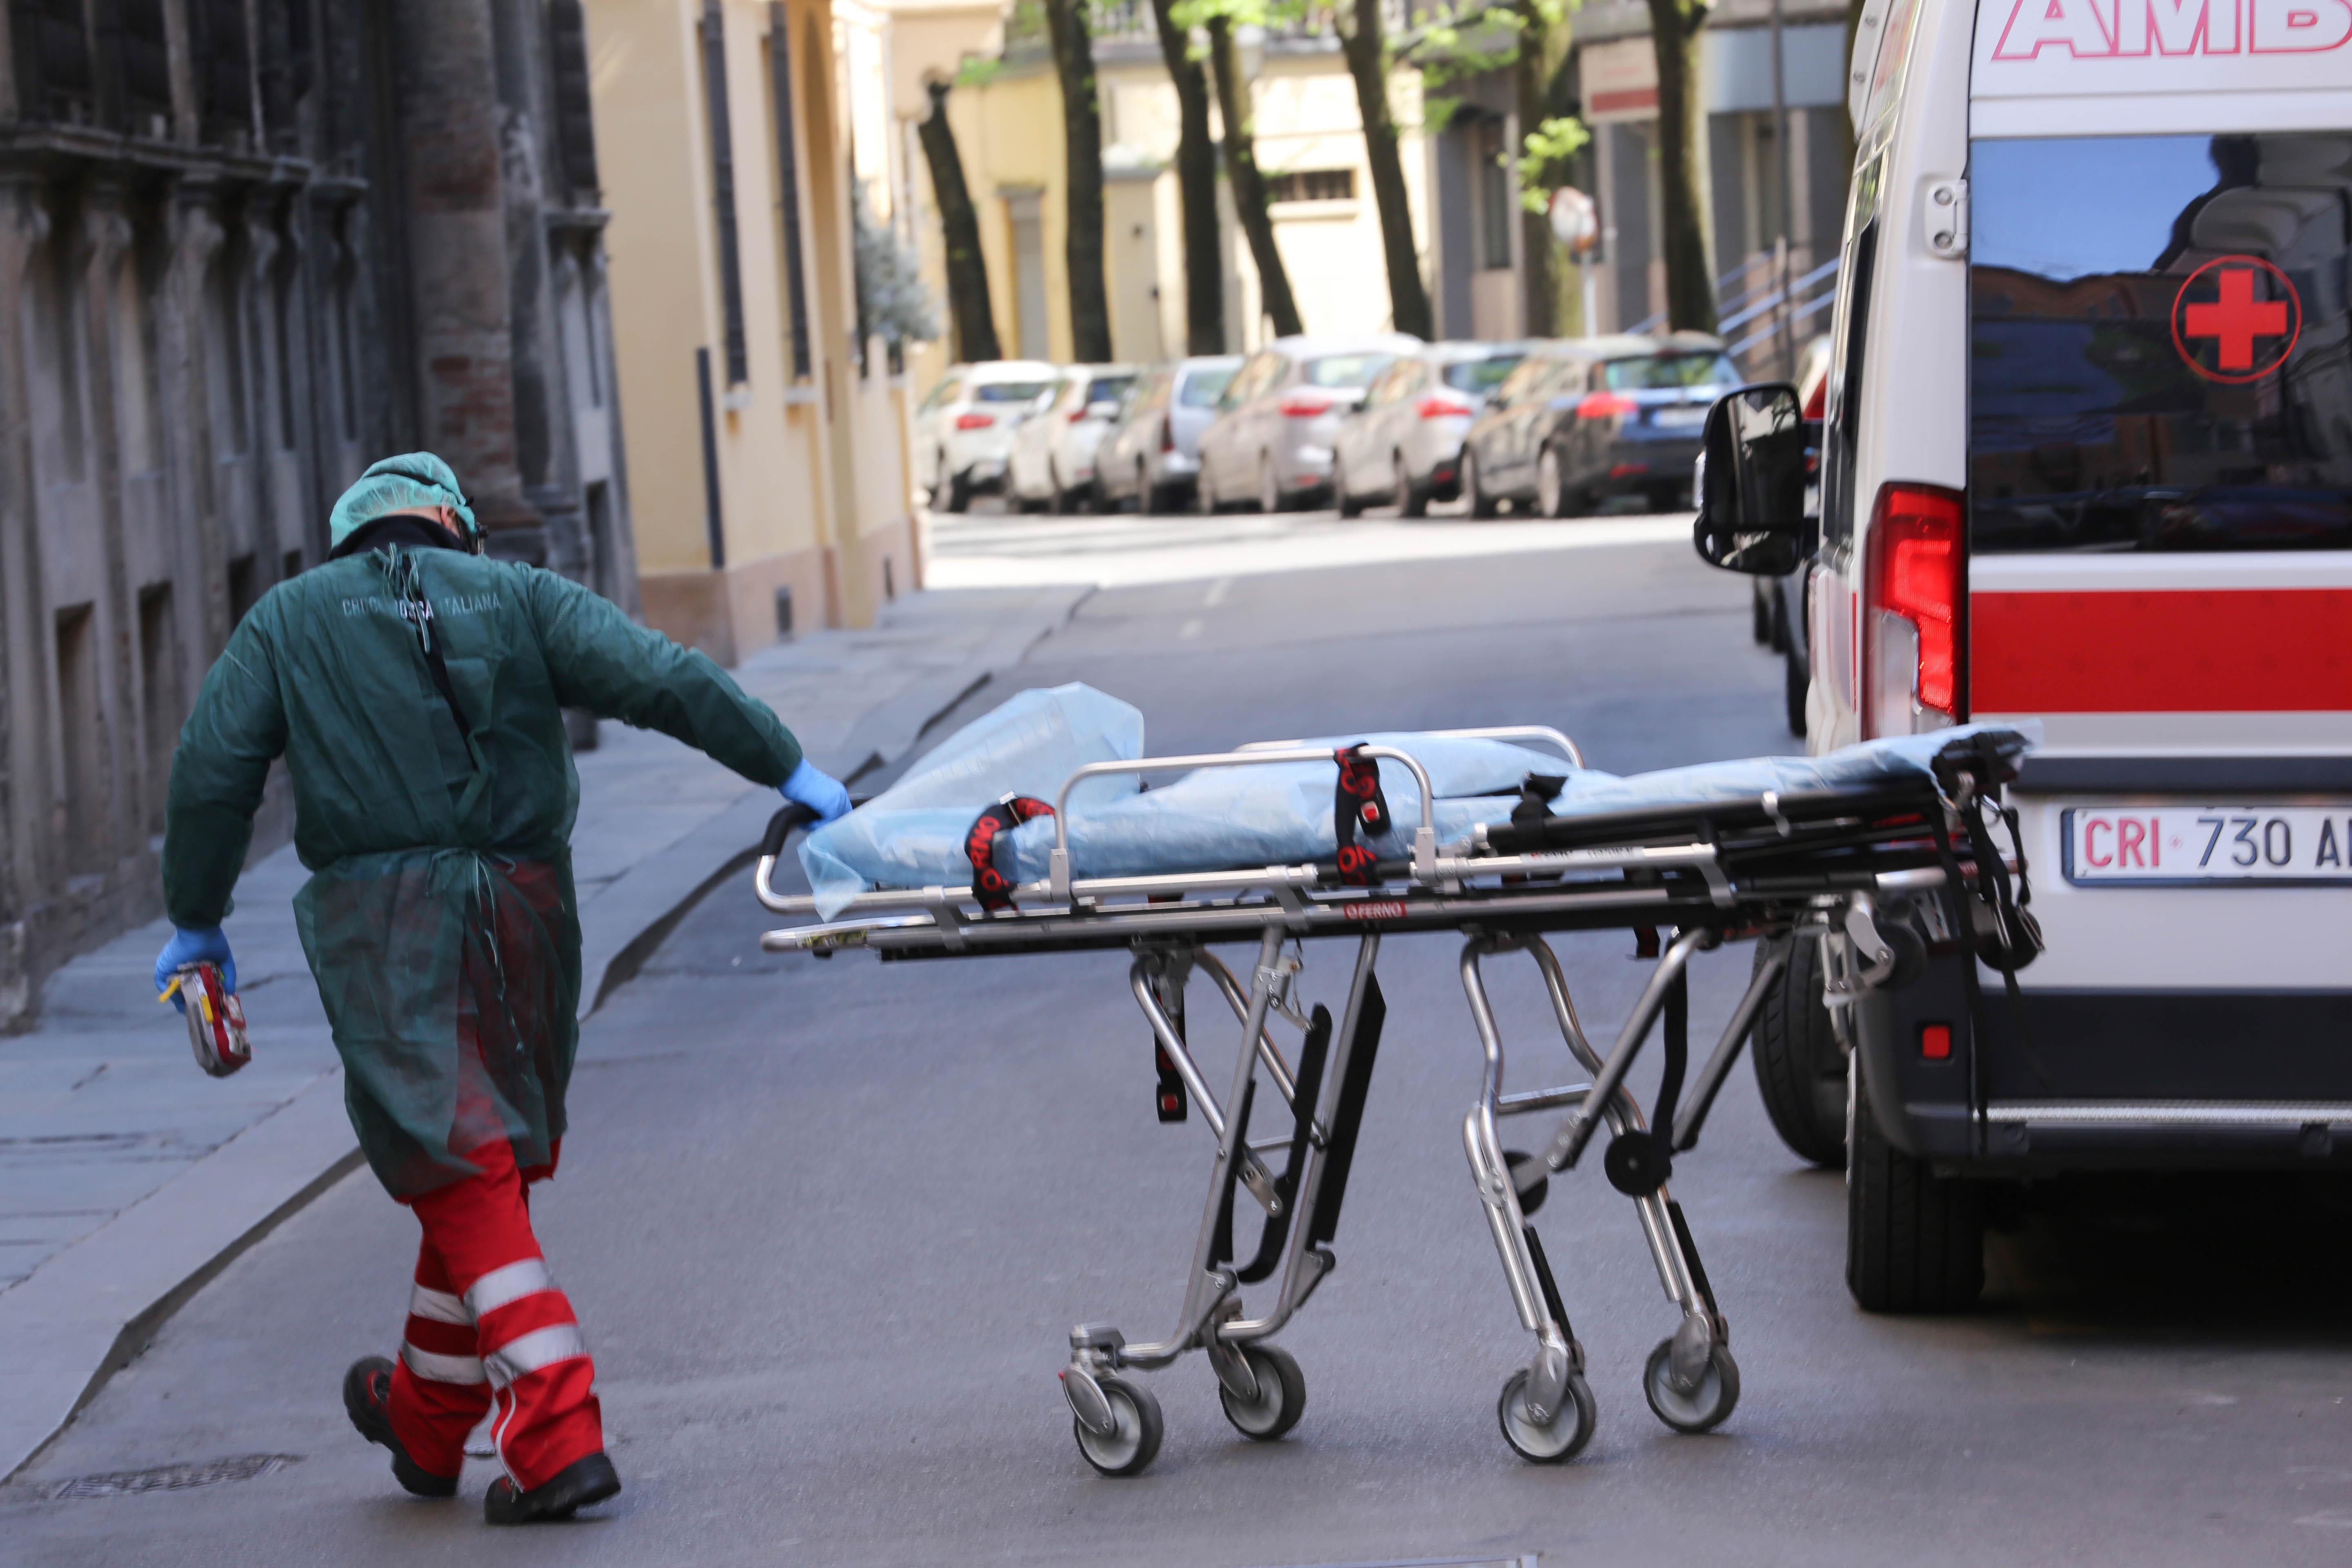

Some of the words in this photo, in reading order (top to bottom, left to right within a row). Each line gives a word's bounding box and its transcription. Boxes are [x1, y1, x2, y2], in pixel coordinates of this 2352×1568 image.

[2085, 818, 2159, 867] CRI
[2197, 818, 2292, 867] 730
[2316, 818, 2352, 866] A
[1358, 902, 1402, 919] FERNO
